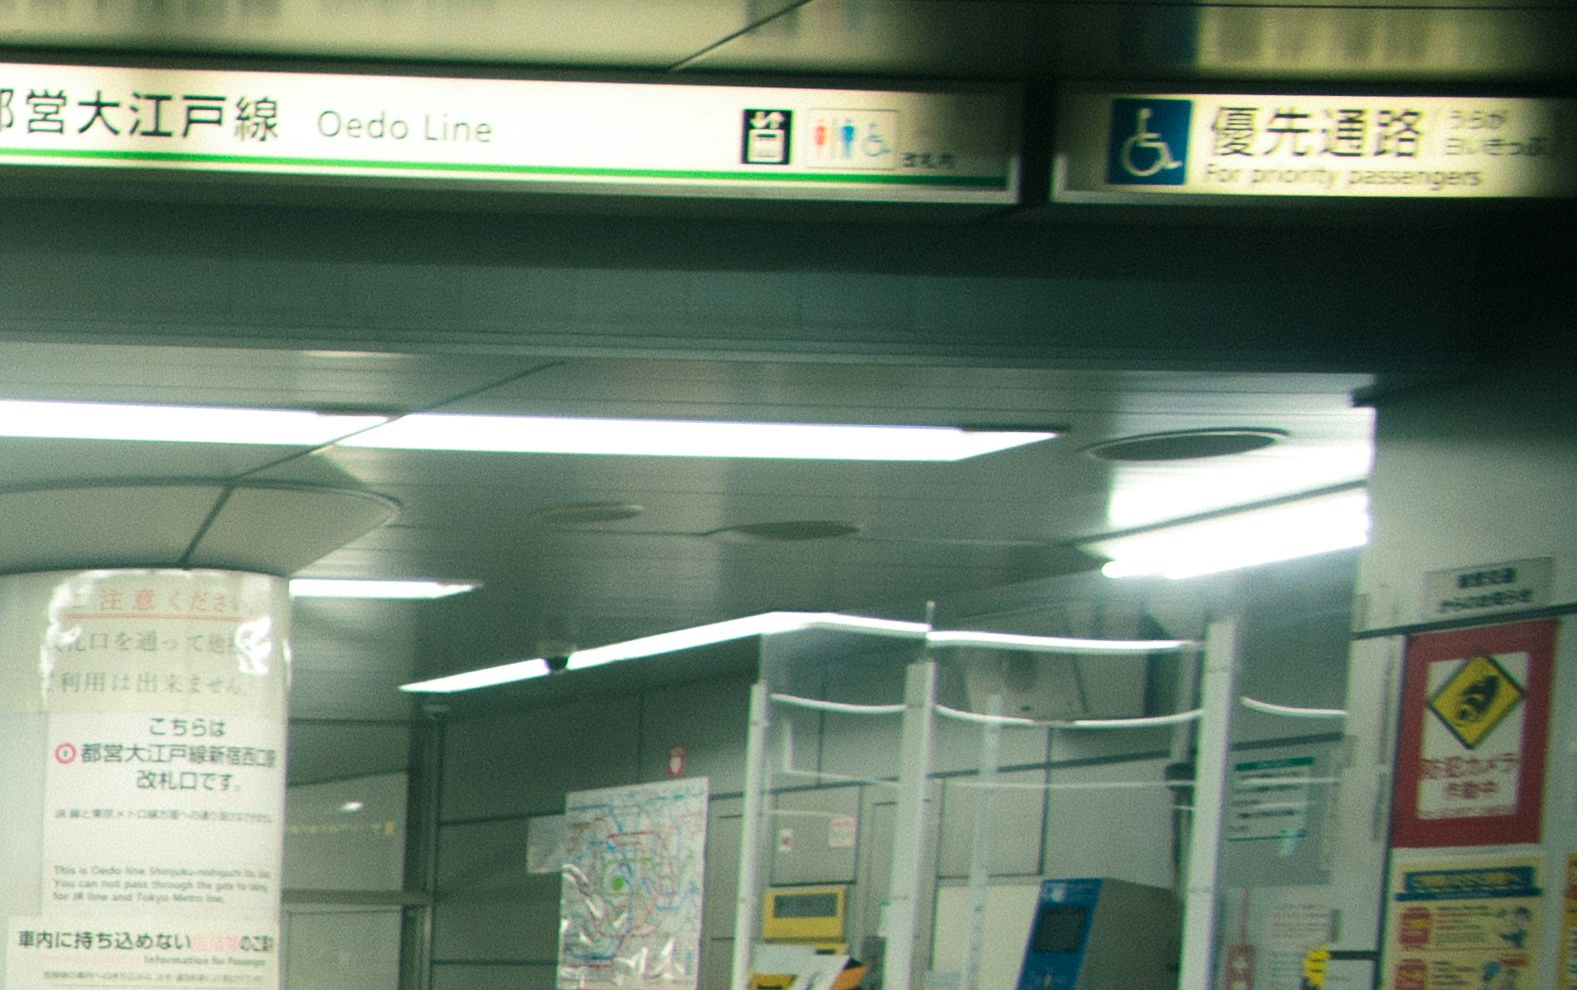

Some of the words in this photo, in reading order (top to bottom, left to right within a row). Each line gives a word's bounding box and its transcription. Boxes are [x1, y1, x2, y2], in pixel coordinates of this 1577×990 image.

[317, 108, 410, 141] Oedo
[425, 112, 493, 144] Line
[1210, 106, 1425, 159] 優先通路
[1205, 161, 1240, 185] For
[1251, 163, 1338, 191] priority
[1349, 166, 1484, 192] passengers
[148, 717, 227, 737] こちらは
